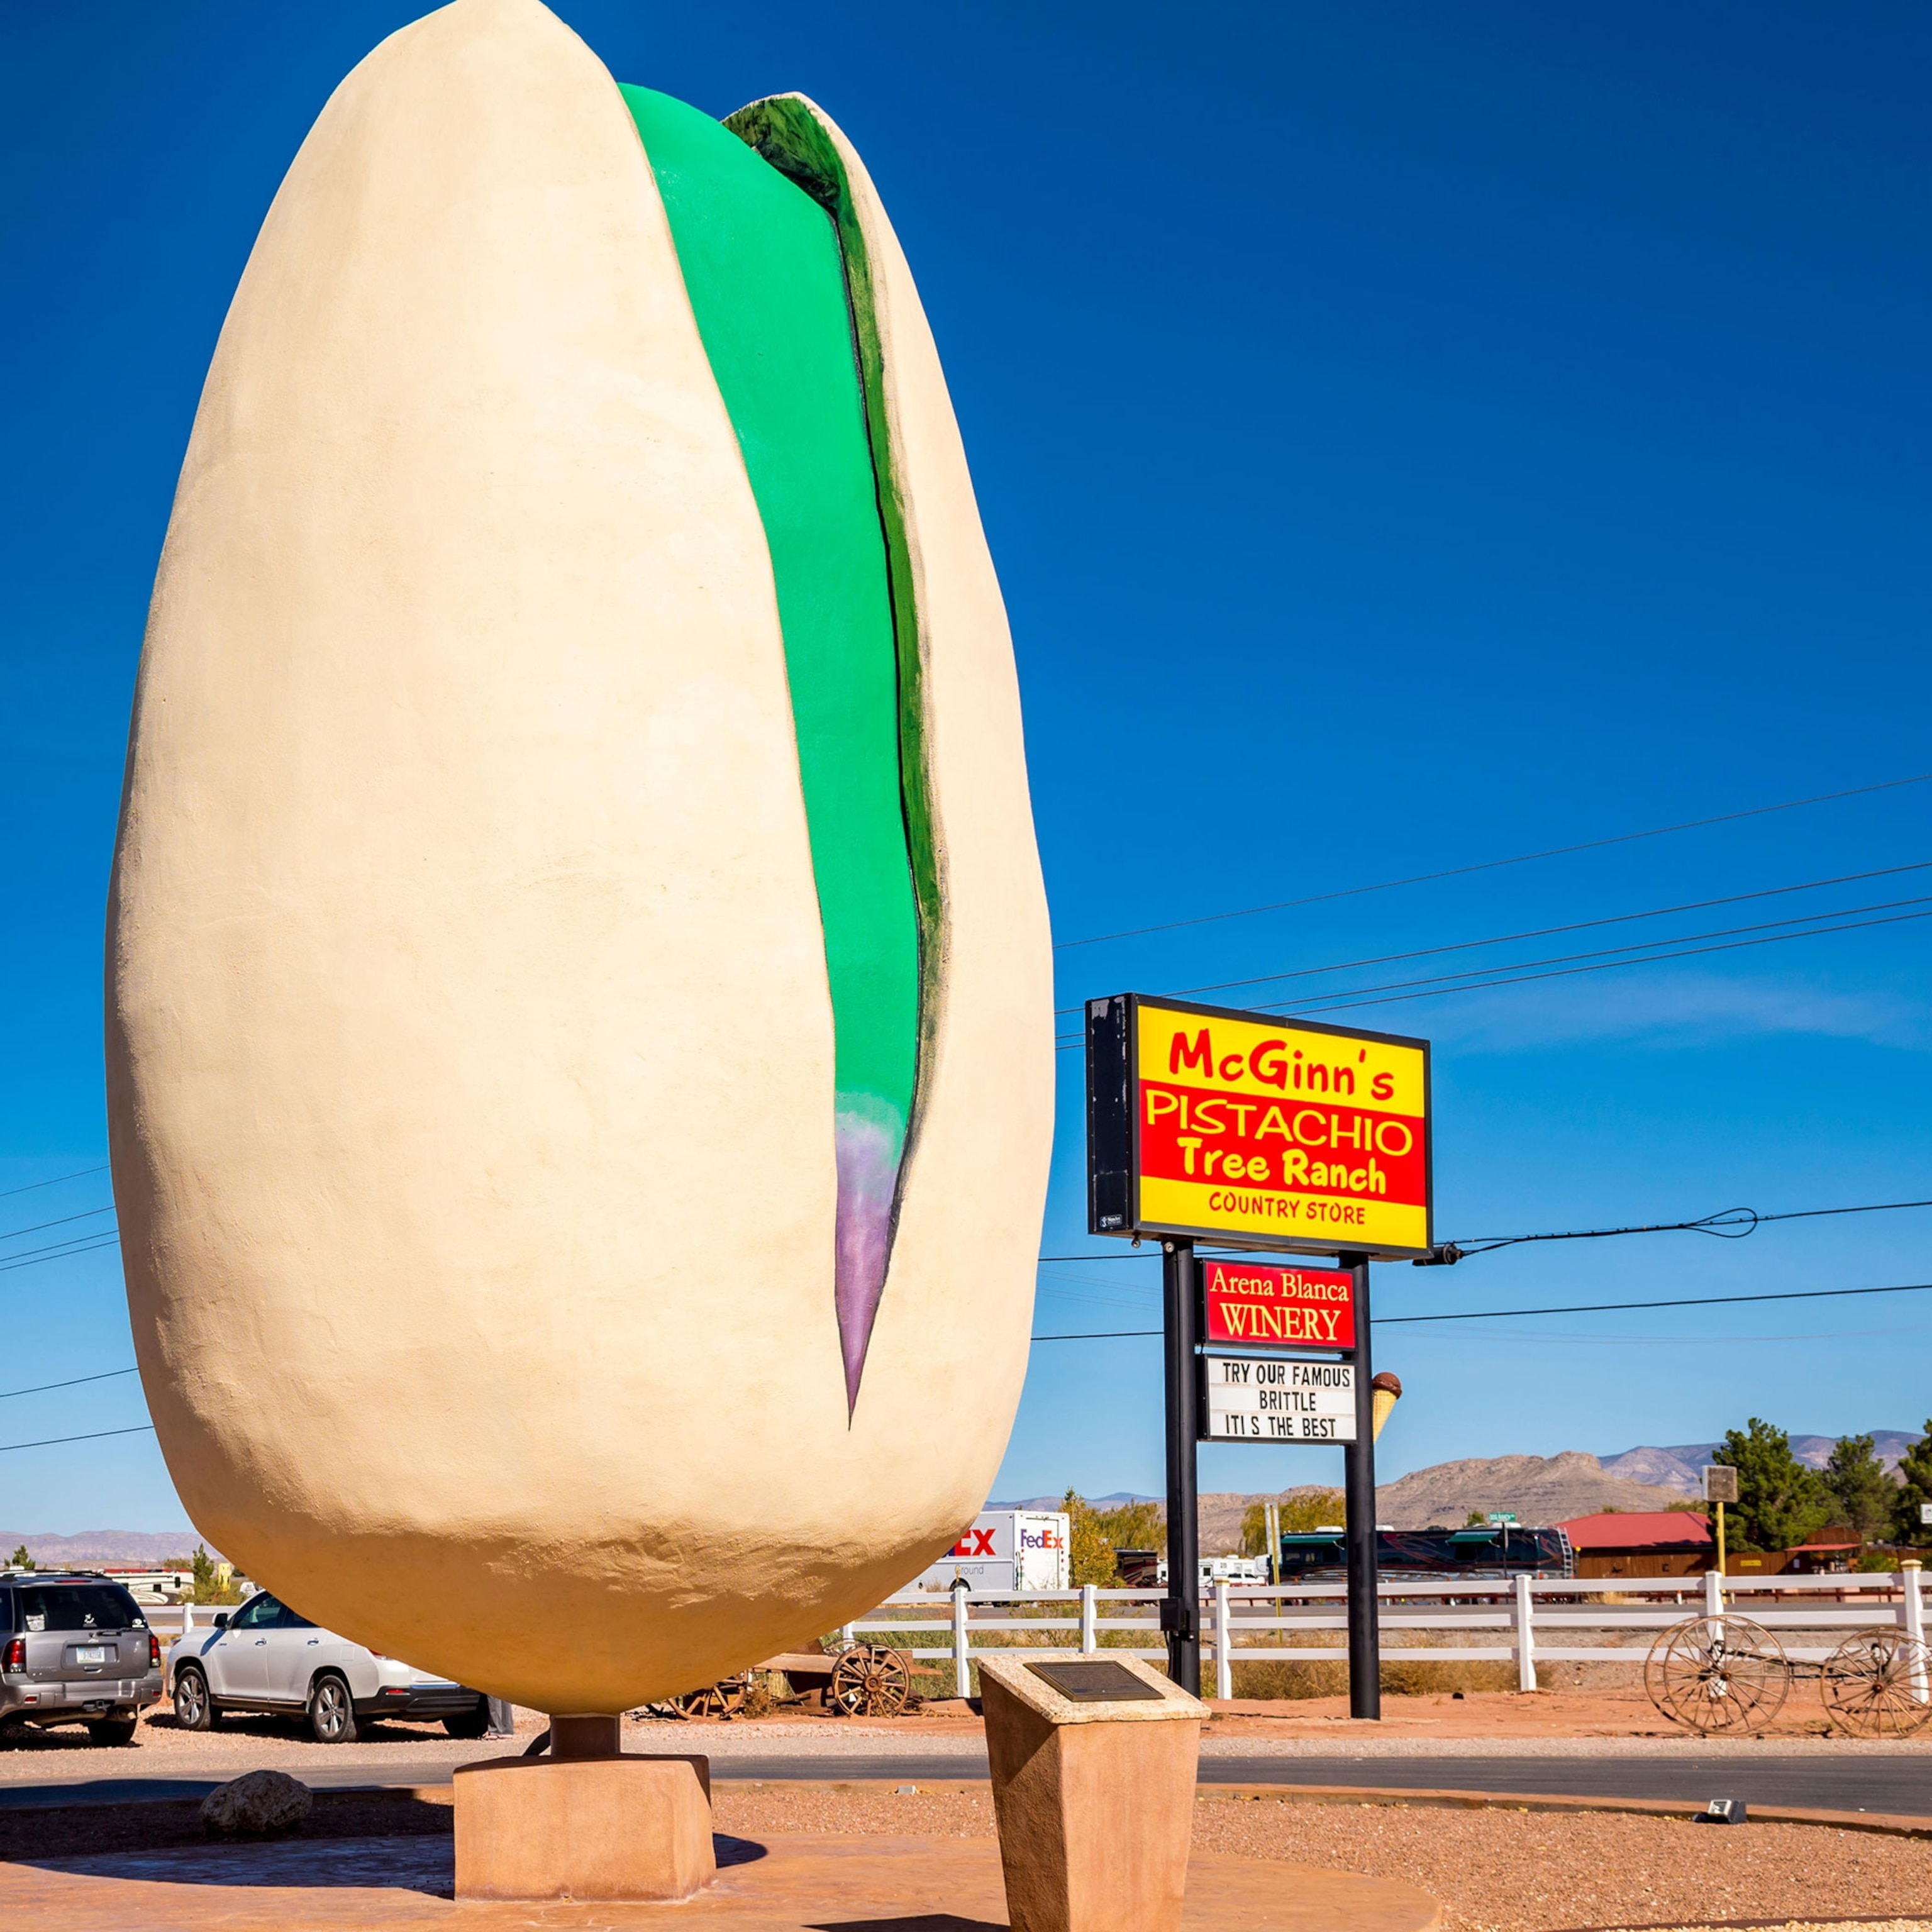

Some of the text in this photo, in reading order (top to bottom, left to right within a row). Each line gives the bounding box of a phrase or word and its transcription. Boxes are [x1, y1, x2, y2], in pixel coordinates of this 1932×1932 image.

[1169, 1028, 1394, 1101] McGinn's
[1145, 1089, 1413, 1157] PISTACHIO
[1177, 1136, 1387, 1194] Tree Ranch
[1209, 1191, 1366, 1225] COUNTRY STORE
[1209, 1267, 1350, 1302] Arena Blanca
[1219, 1302, 1341, 1341] WINERY
[1223, 1362, 1350, 1387] TRY OUR FAMOUS
[1259, 1390, 1316, 1411] BRITTLE
[1268, 1416, 1294, 1436] THE
[1302, 1418, 1336, 1437] BEST
[1020, 1528, 1063, 1549] FedEx
